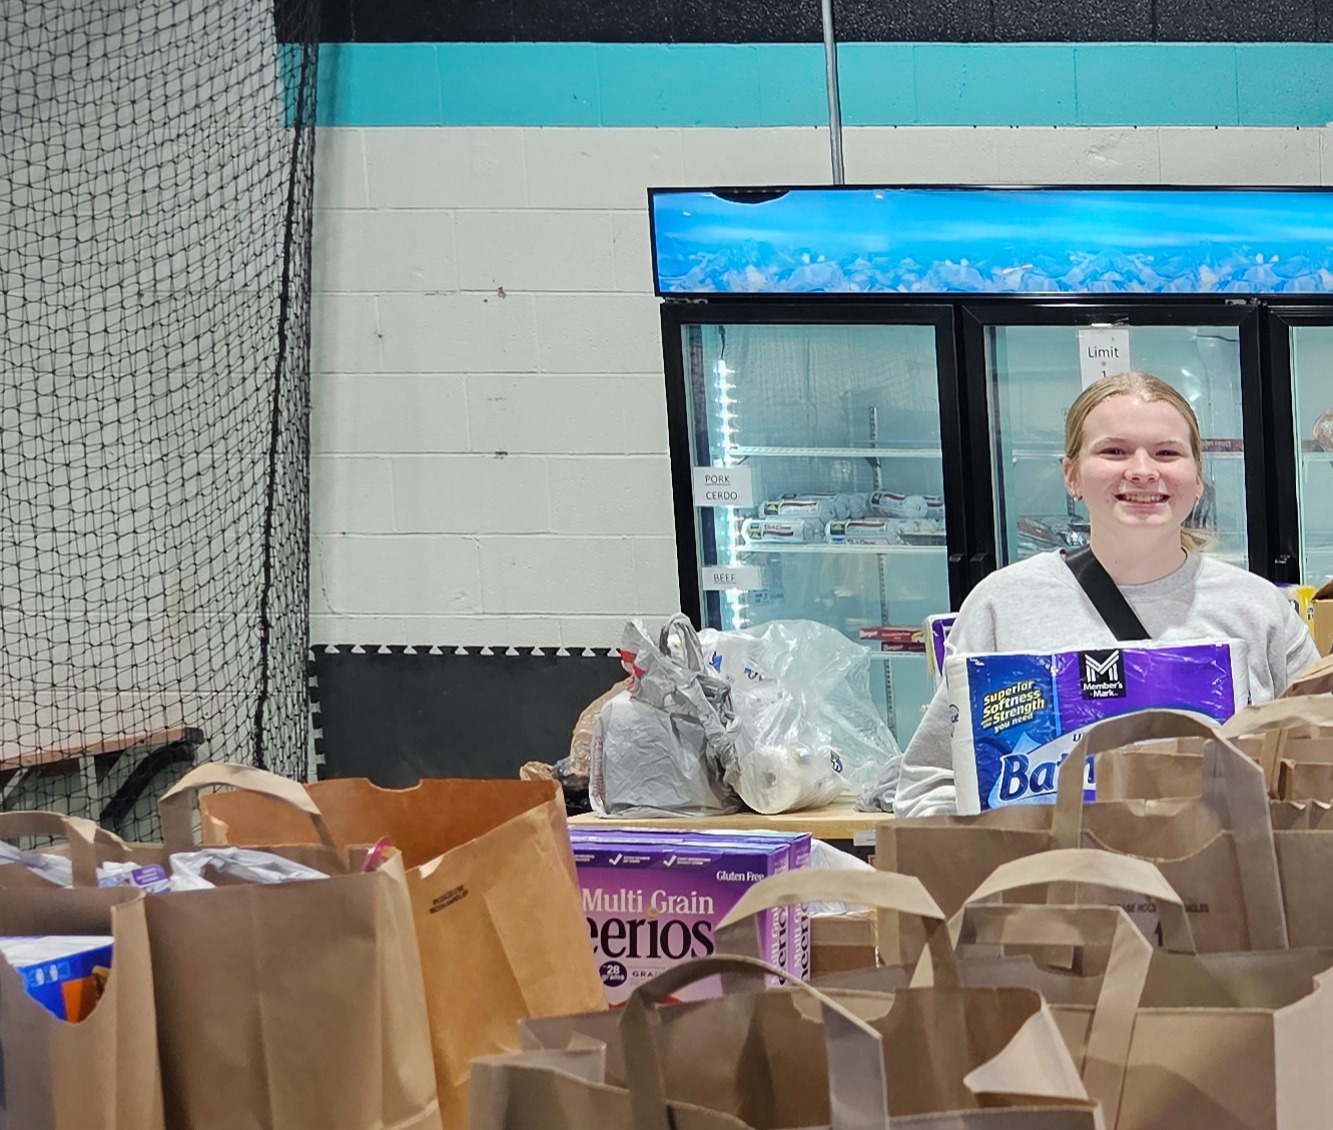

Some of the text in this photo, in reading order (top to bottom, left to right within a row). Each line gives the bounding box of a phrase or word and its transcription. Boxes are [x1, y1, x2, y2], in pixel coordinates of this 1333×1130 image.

[1088, 346, 1119, 358] Limit
[705, 474, 730, 484] PORK
[706, 491, 738, 500] CERDO
[713, 573, 736, 583] BEEF
[1083, 681, 1123, 690] Member's
[994, 720, 1011, 734] you
[716, 870, 765, 882] Gluten Free
[582, 888, 715, 914] Multi Grain
[606, 965, 620, 975] 28
